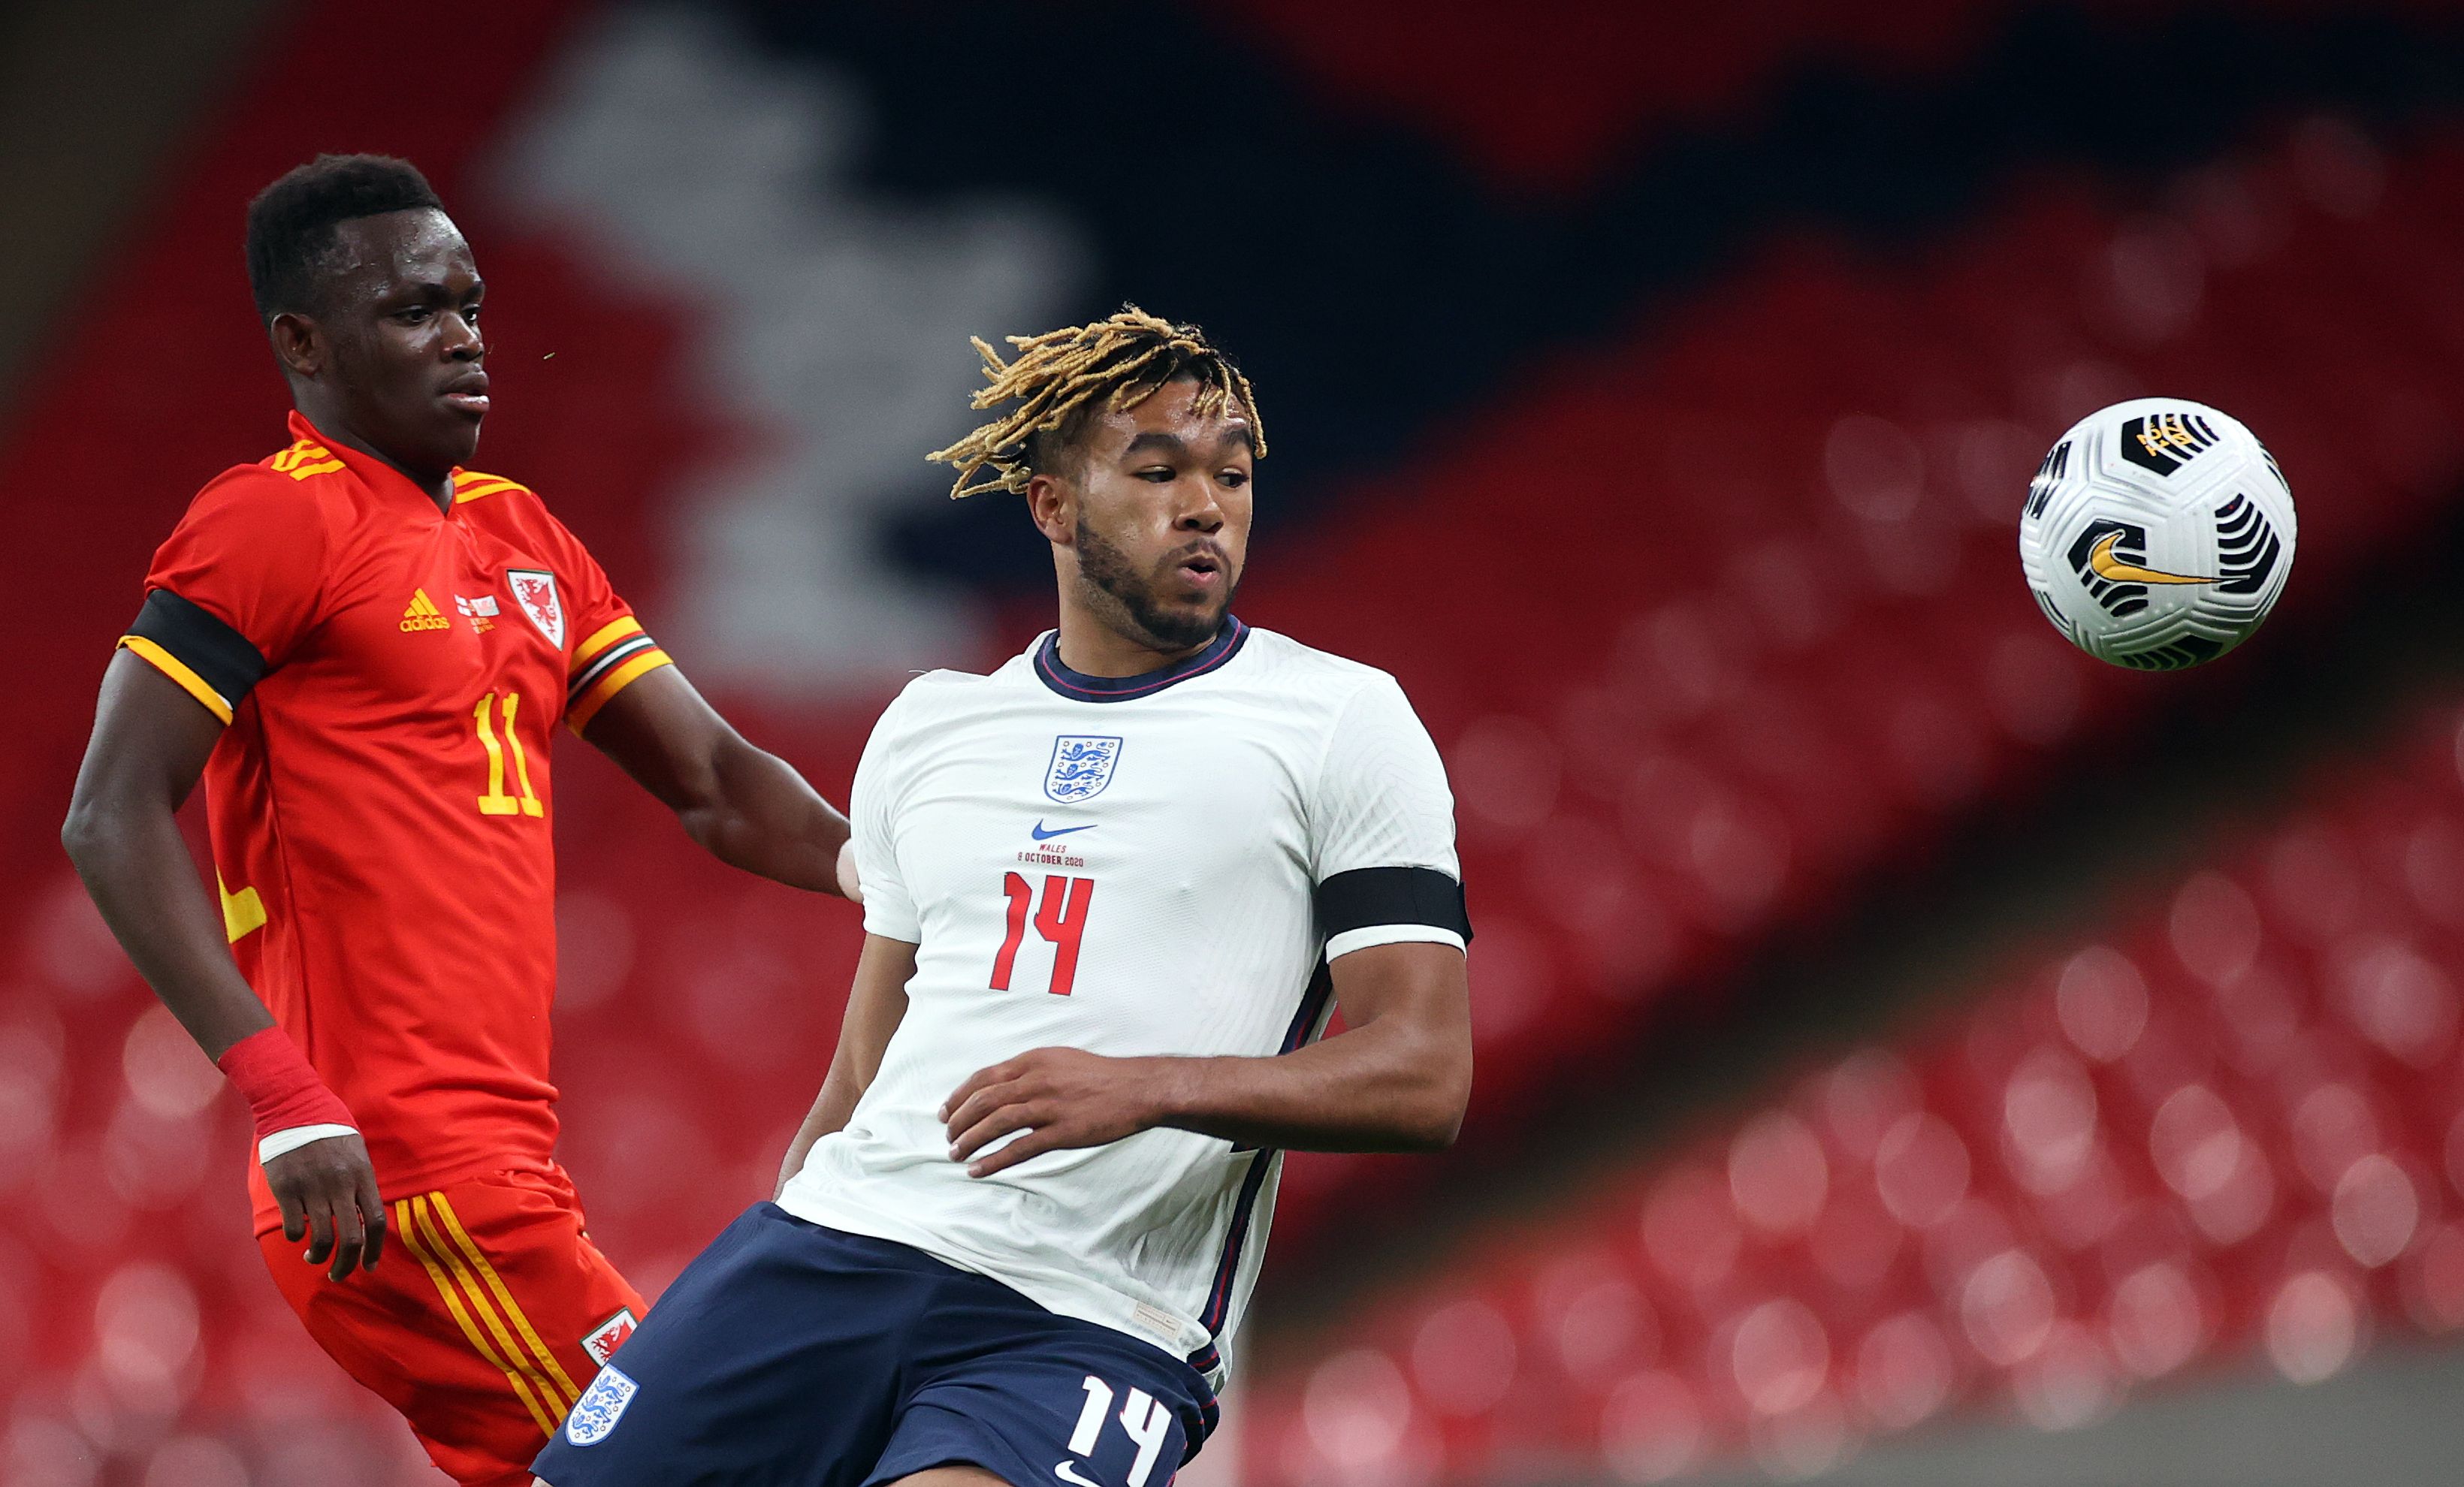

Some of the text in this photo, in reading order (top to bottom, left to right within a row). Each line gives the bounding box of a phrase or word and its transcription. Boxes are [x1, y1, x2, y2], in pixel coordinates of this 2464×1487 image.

[400, 616, 451, 632] adidas
[473, 692, 545, 819] 11
[1018, 852, 1083, 867] 8 OCTOBER 2020
[1039, 843, 1067, 853] WALES
[989, 871, 1095, 997] 14
[1067, 1375, 1173, 1487] 14
